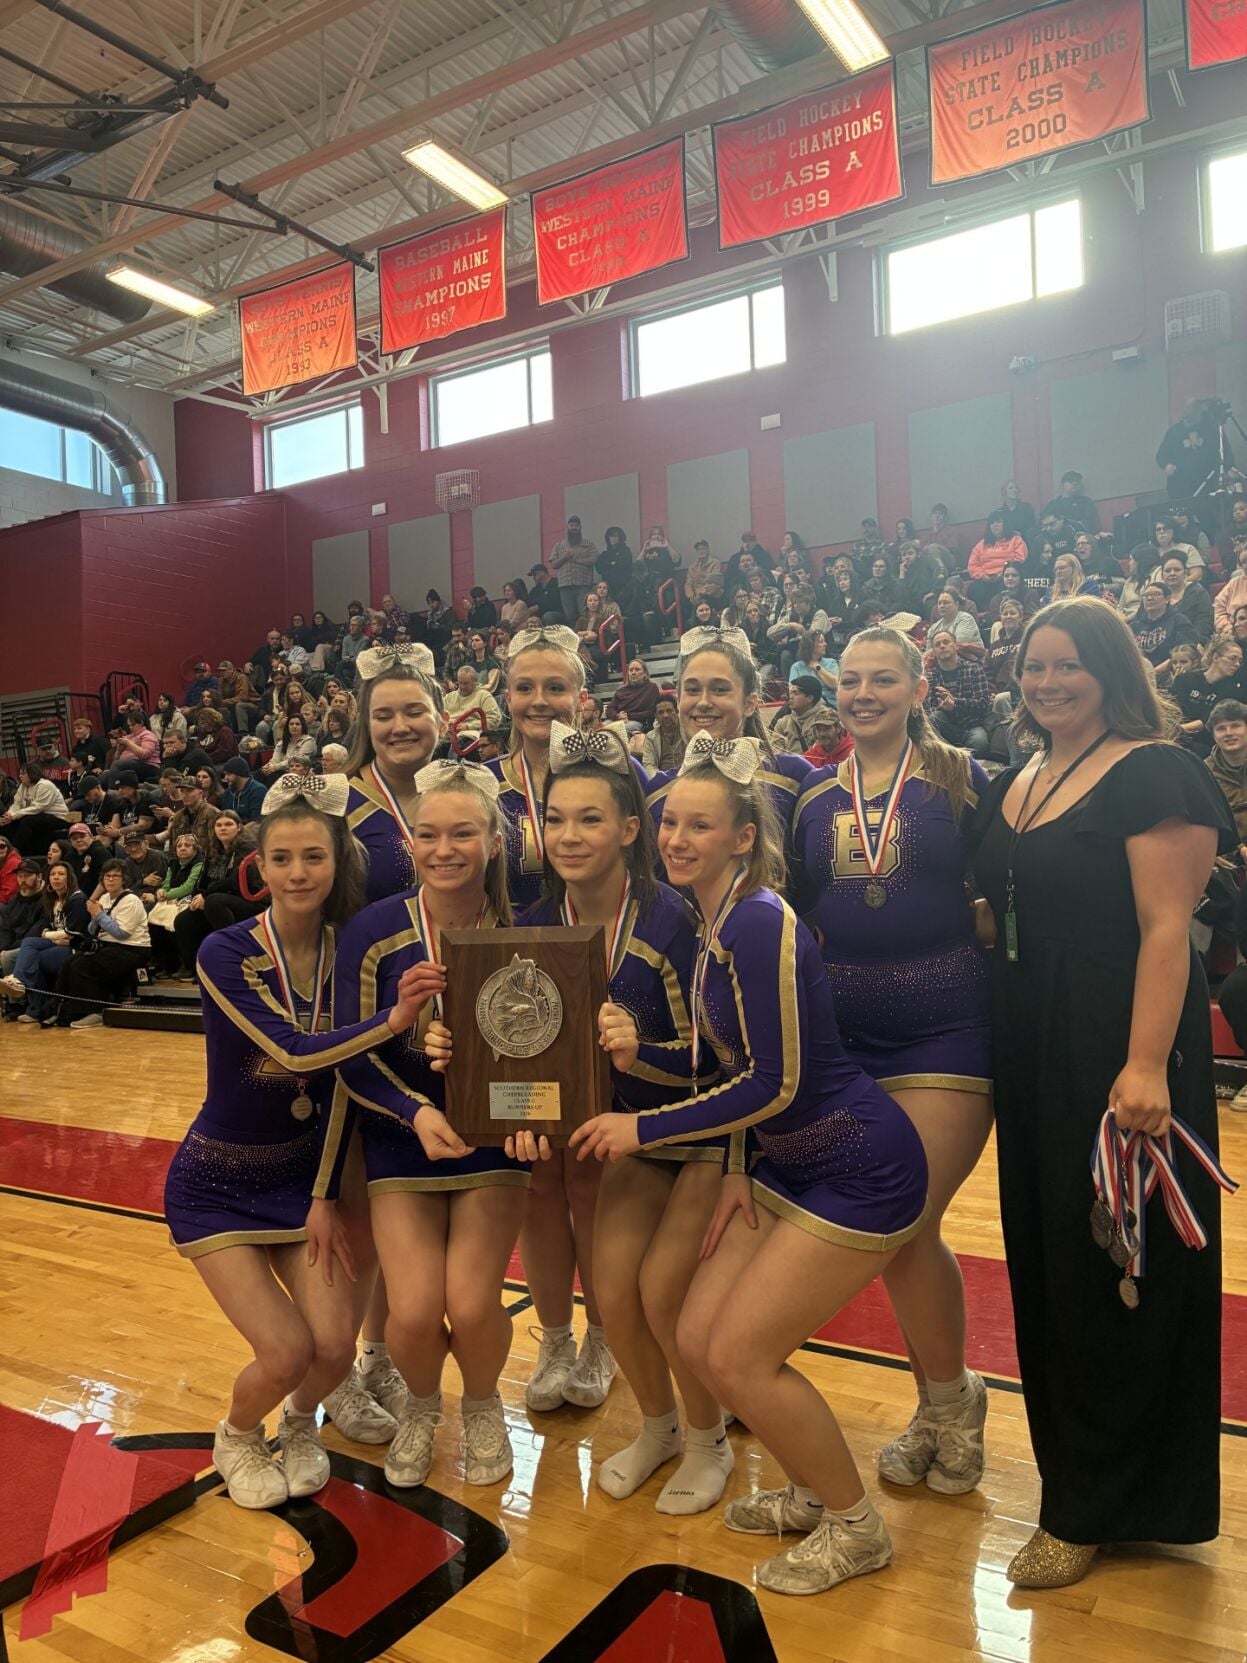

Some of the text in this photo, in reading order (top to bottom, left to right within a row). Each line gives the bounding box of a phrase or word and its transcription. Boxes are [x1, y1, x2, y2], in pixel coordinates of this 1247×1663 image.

[961, 11, 1108, 72] FIELD HOCKEY
[944, 29, 1129, 106] STATE CHAMPIONS
[742, 90, 862, 147] FIELD HOCKEY
[967, 71, 1105, 131] CLASS A
[789, 110, 883, 159] CHAMPIONS
[1006, 112, 1067, 150] 2000
[750, 150, 863, 201] CLASS A
[541, 197, 612, 233] WESTERN
[557, 202, 660, 250] CHAMPIONS
[783, 189, 830, 219] 1999
[395, 228, 488, 272] BASEBALL
[453, 249, 489, 275] MAINE
[569, 236, 626, 267] CLASS
[393, 272, 492, 318] CHAMPIONS
[426, 306, 455, 330] 1997
[319, 336, 328, 348] A
